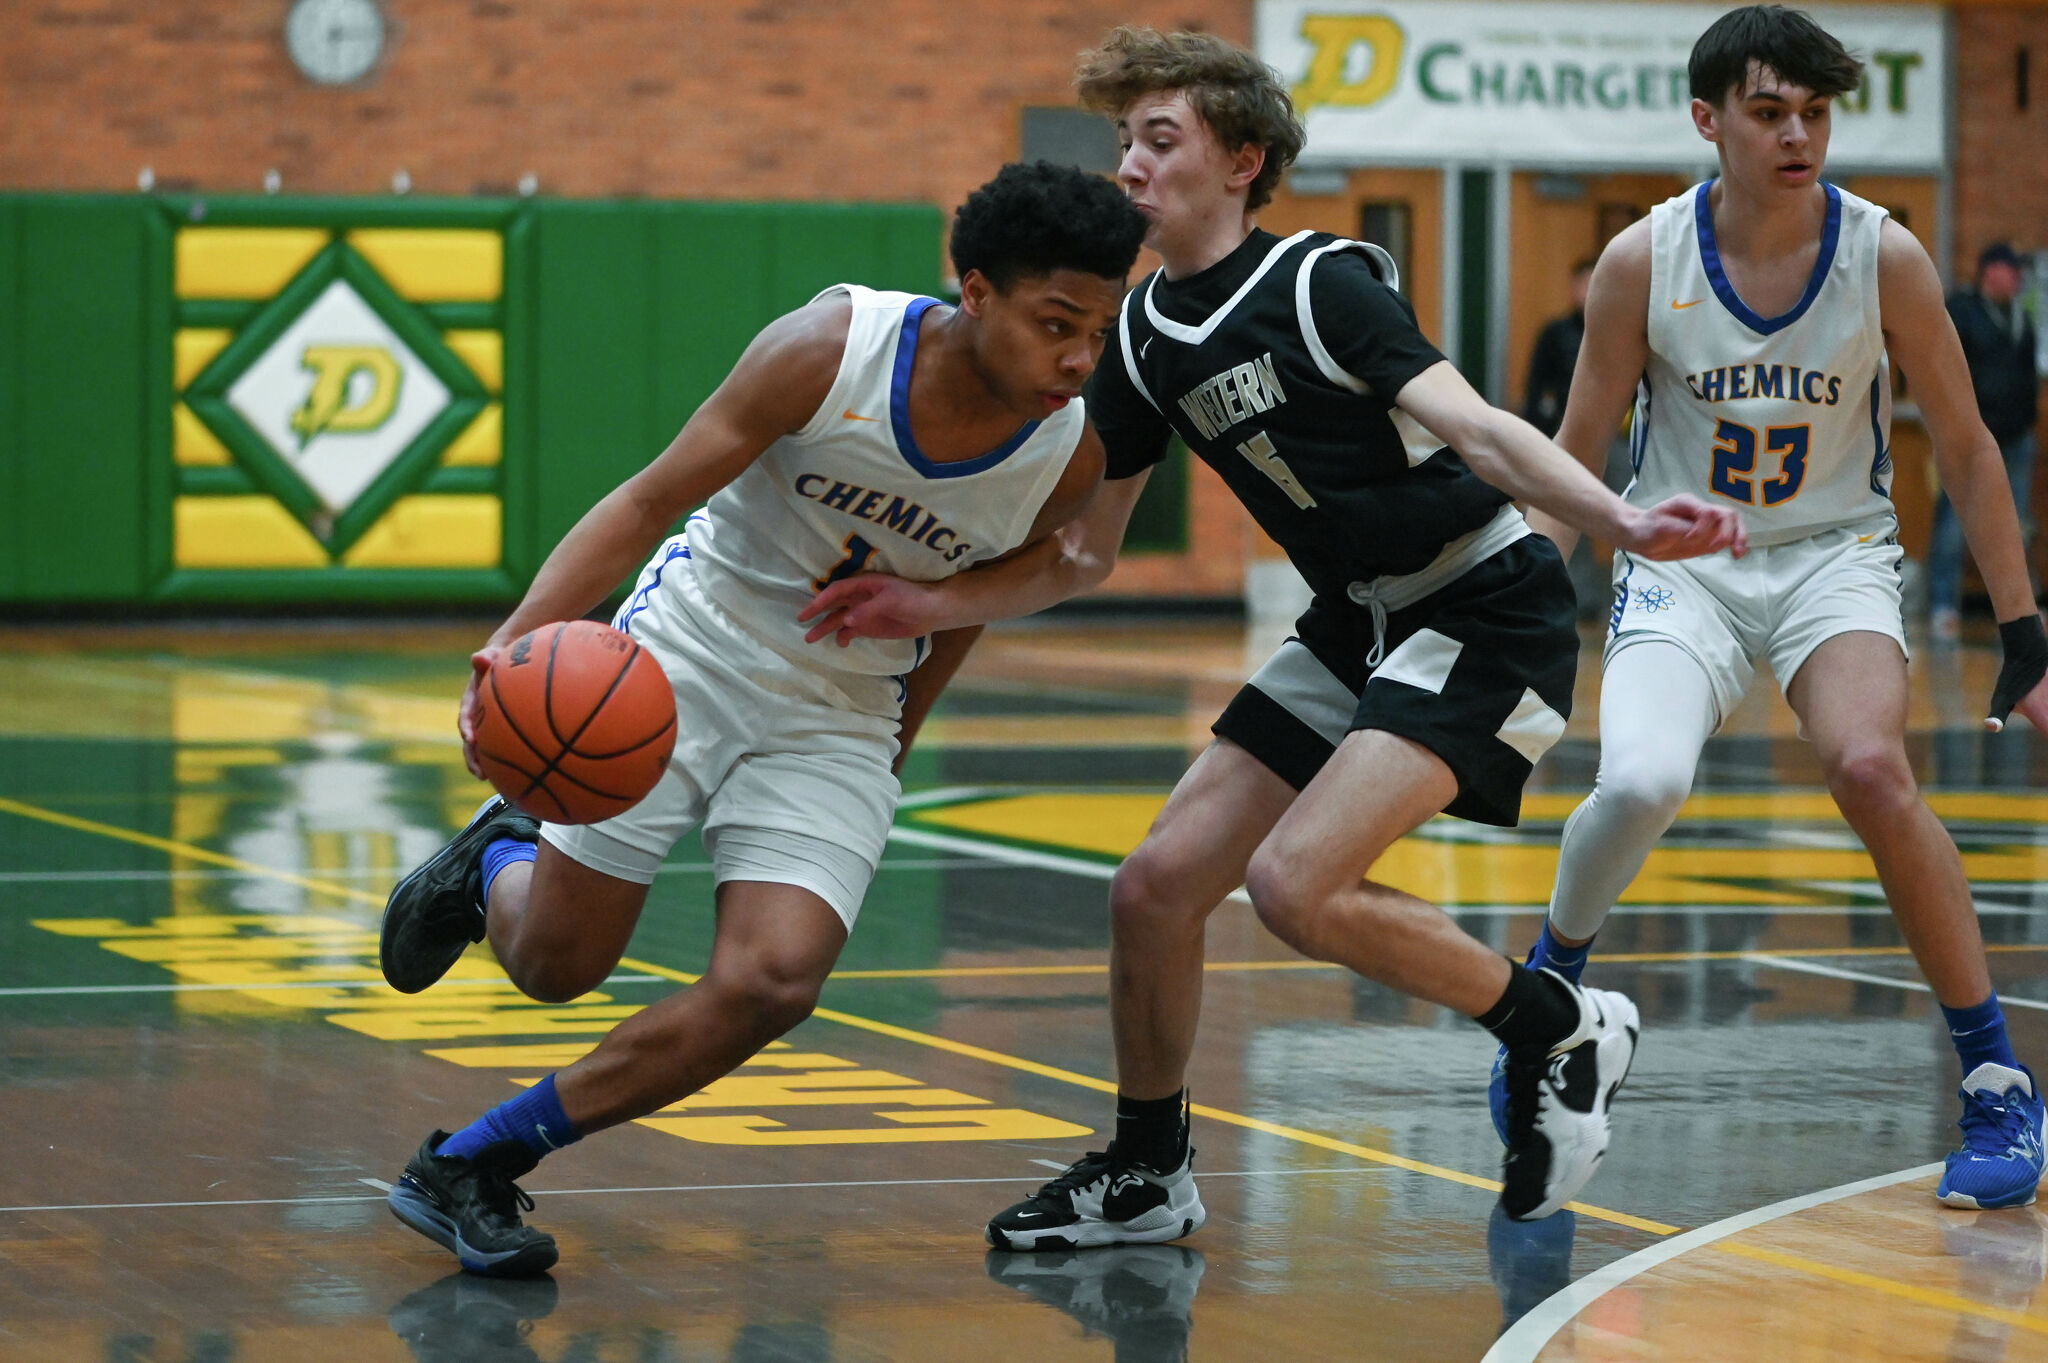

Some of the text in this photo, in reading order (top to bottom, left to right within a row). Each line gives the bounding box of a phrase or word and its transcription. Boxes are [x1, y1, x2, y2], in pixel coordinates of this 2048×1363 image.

[1177, 352, 1287, 440] WETERN
[1708, 416, 1812, 508] 23
[795, 473, 972, 562] CHEMICS
[811, 531, 881, 595] 1
